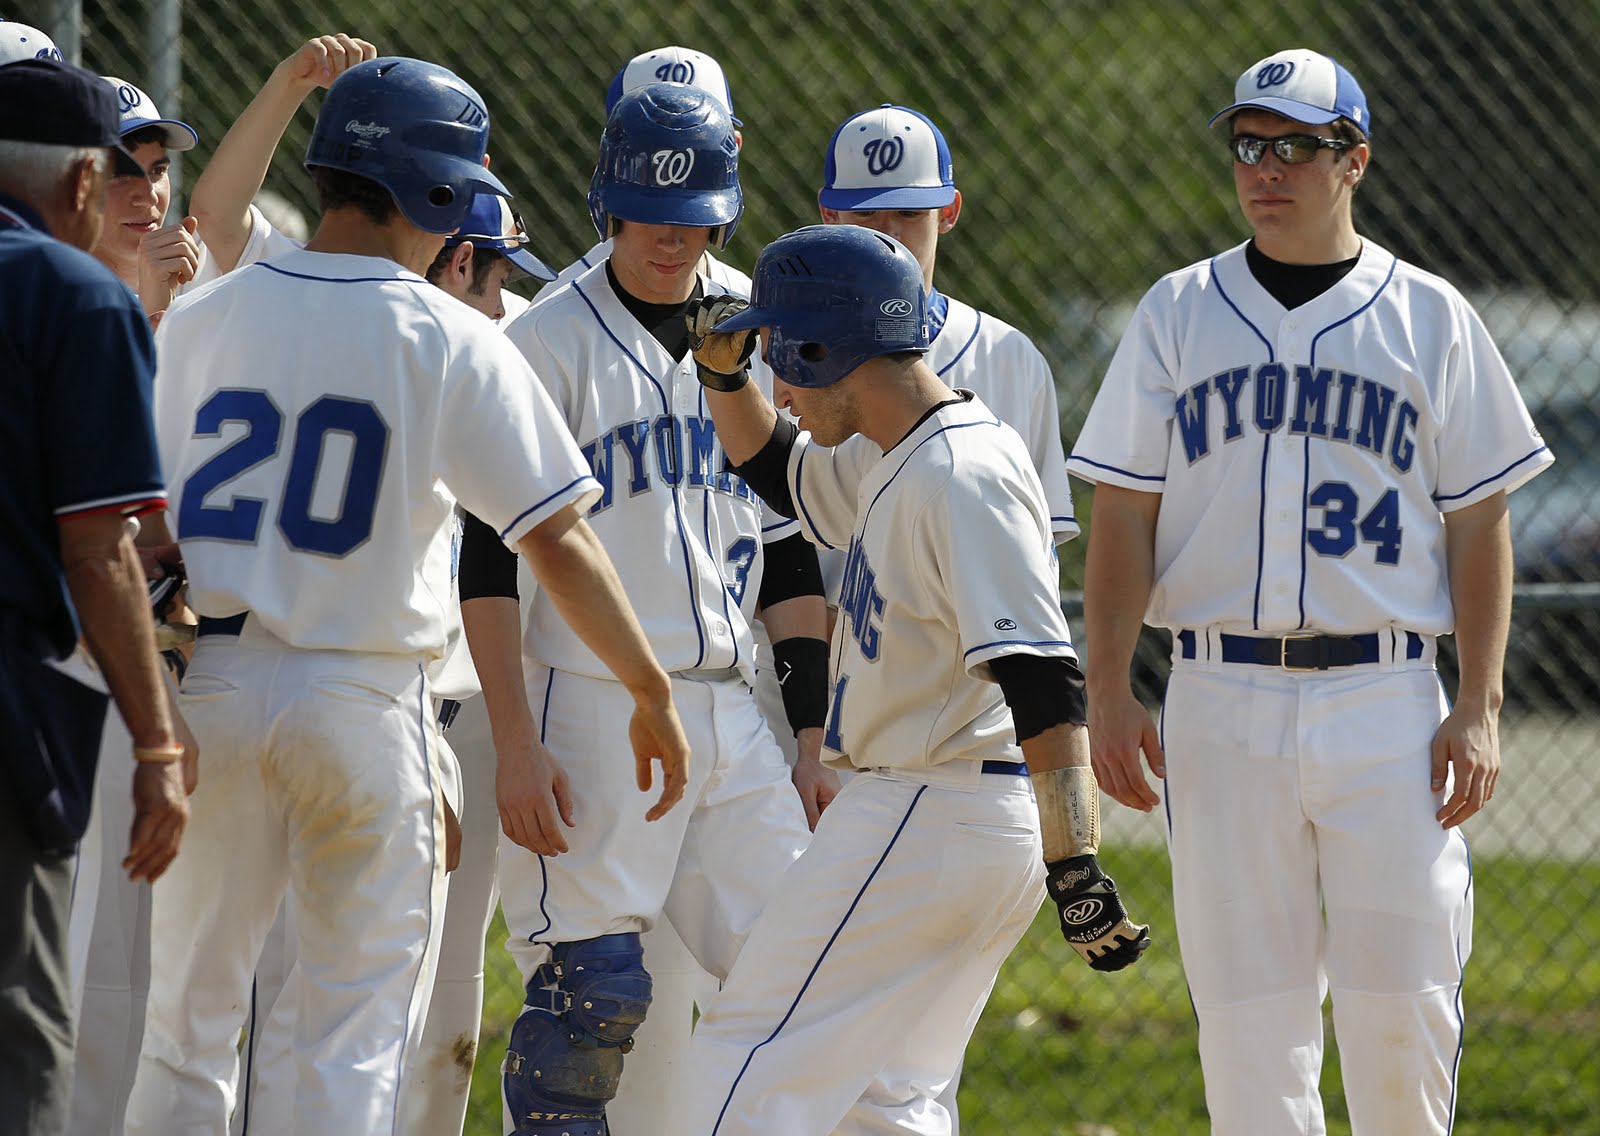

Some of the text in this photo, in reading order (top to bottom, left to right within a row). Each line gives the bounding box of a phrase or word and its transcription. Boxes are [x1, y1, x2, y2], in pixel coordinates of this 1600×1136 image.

[1257, 61, 1295, 89] W
[345, 120, 391, 138] Rawlings
[653, 147, 695, 186] W
[863, 135, 904, 177] W
[1175, 362, 1419, 475] WYOMING
[178, 387, 392, 560] 20
[1307, 480, 1403, 567] 34
